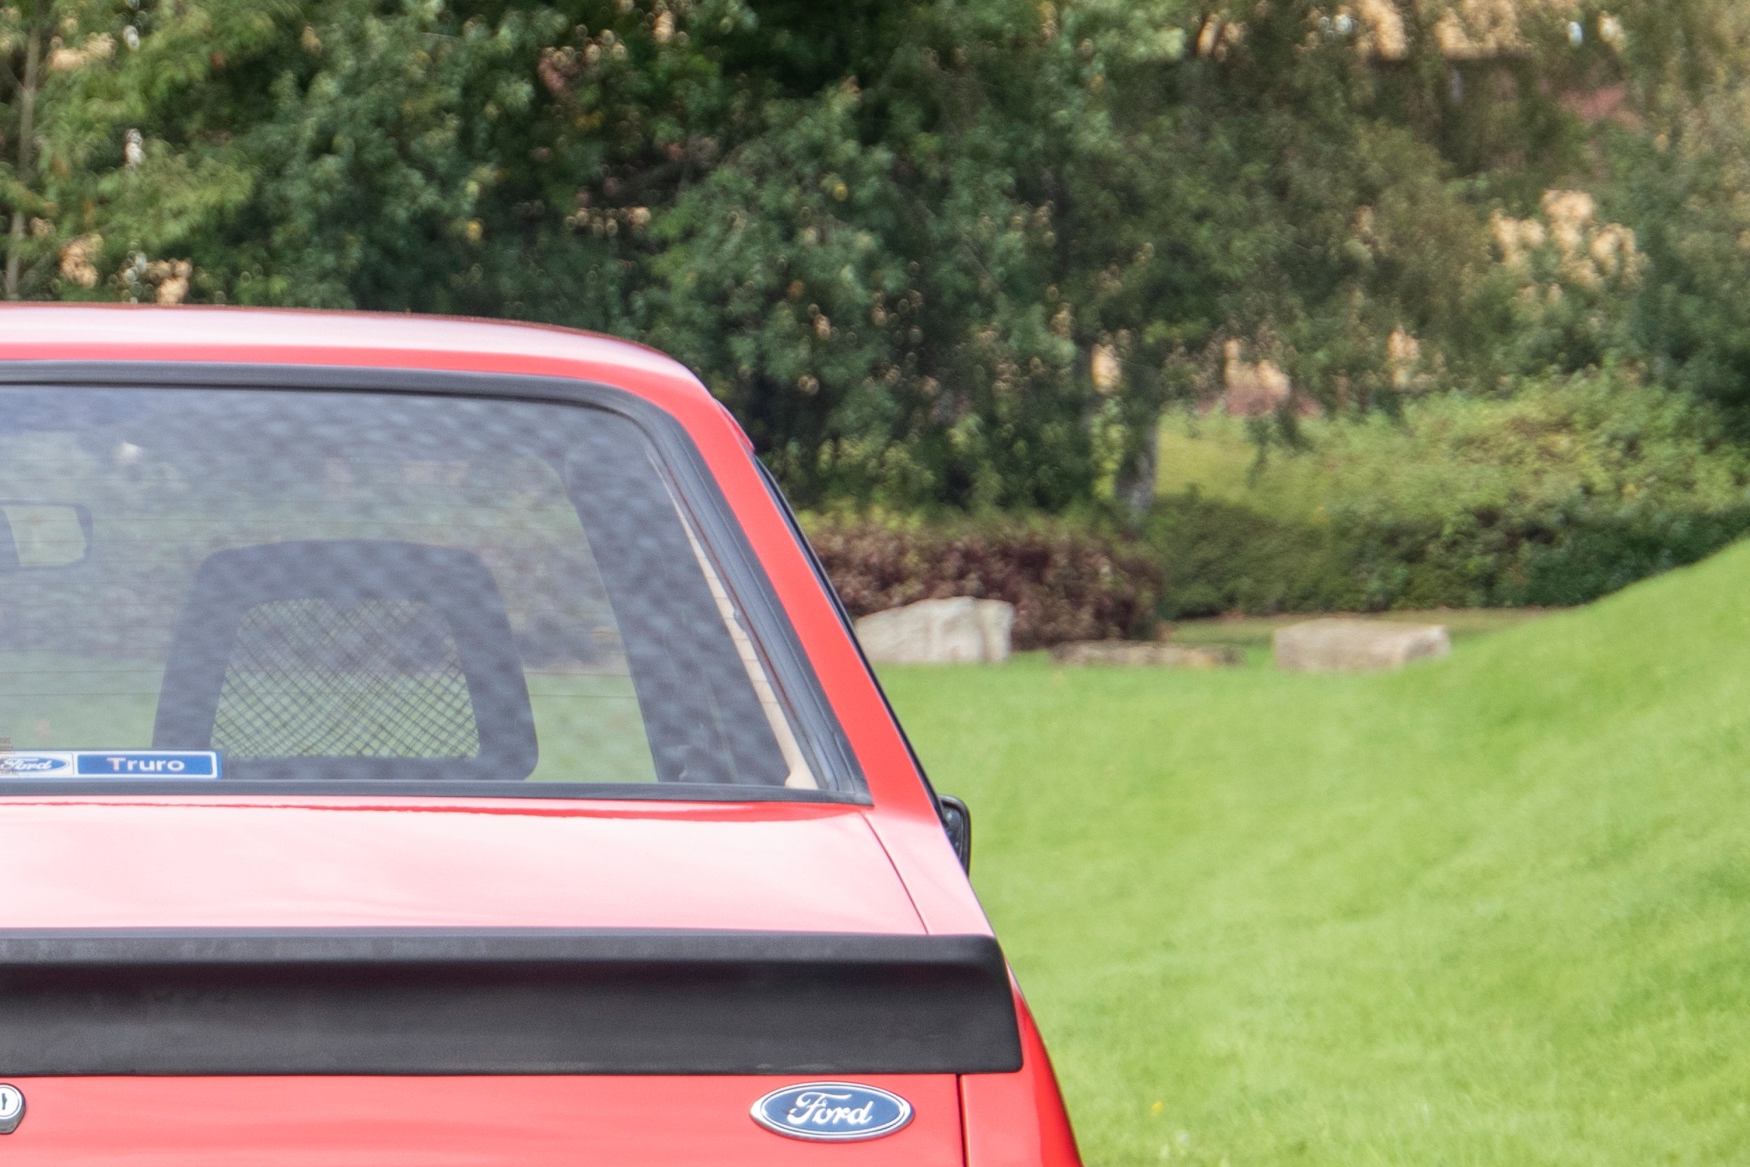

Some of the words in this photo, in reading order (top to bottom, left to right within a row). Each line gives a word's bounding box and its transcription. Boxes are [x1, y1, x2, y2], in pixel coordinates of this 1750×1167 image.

[0, 757, 53, 771] Ford
[106, 757, 186, 773] Truro
[786, 1091, 874, 1125] Ford
